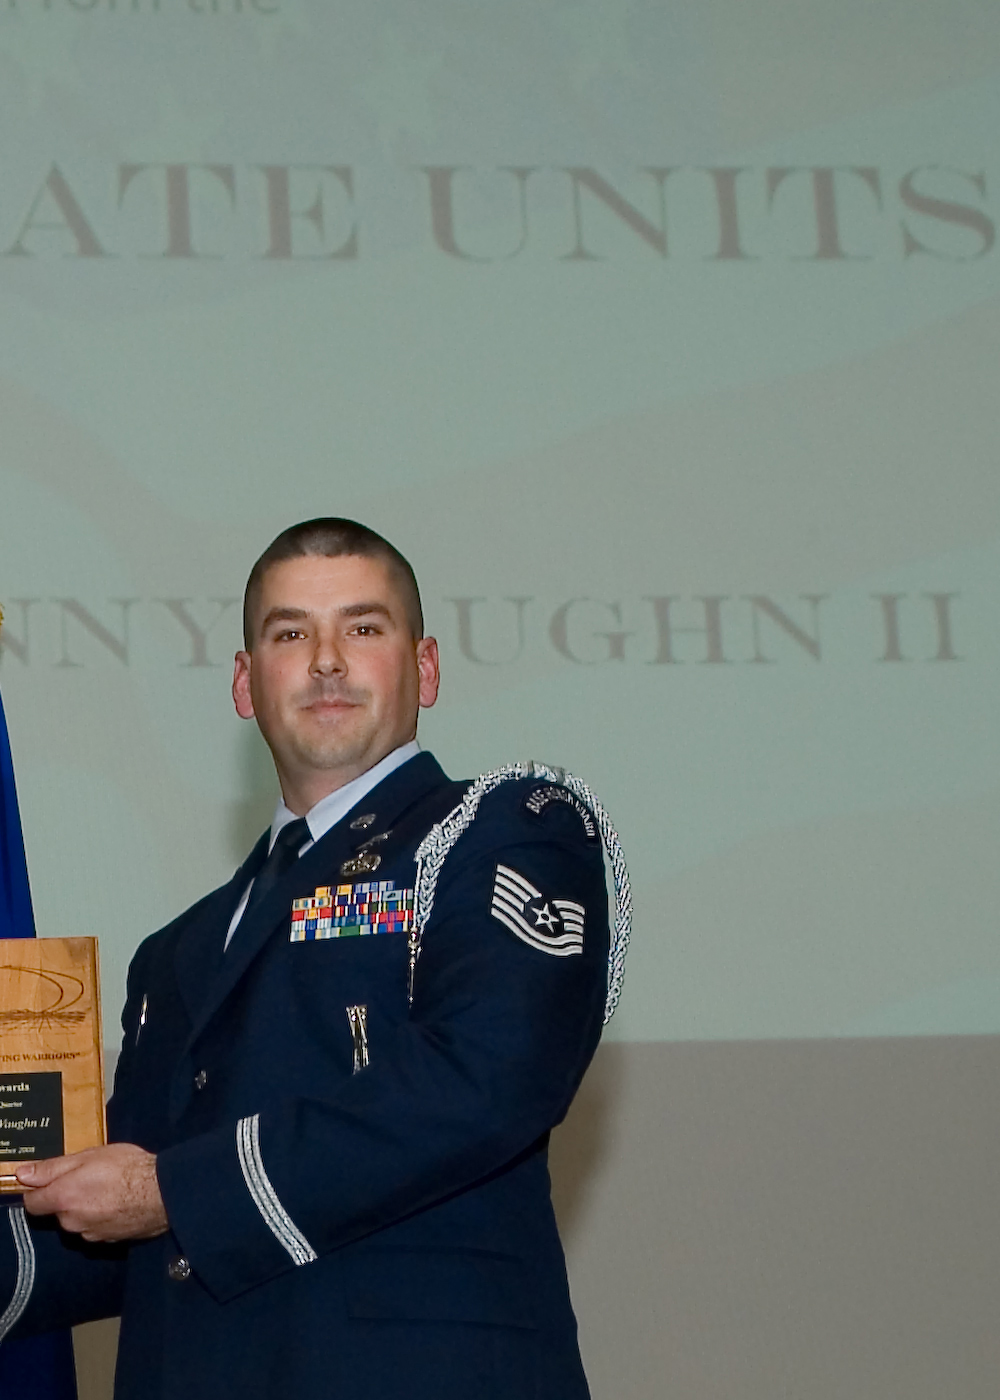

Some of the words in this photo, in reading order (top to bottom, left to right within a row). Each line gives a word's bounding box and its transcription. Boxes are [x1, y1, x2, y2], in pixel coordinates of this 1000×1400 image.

[420, 163, 997, 263] UNITS
[441, 592, 831, 666] UGHN
[870, 591, 965, 664] II
[0, 1117, 38, 1131] Vaughn
[40, 1117, 50, 1128] II
